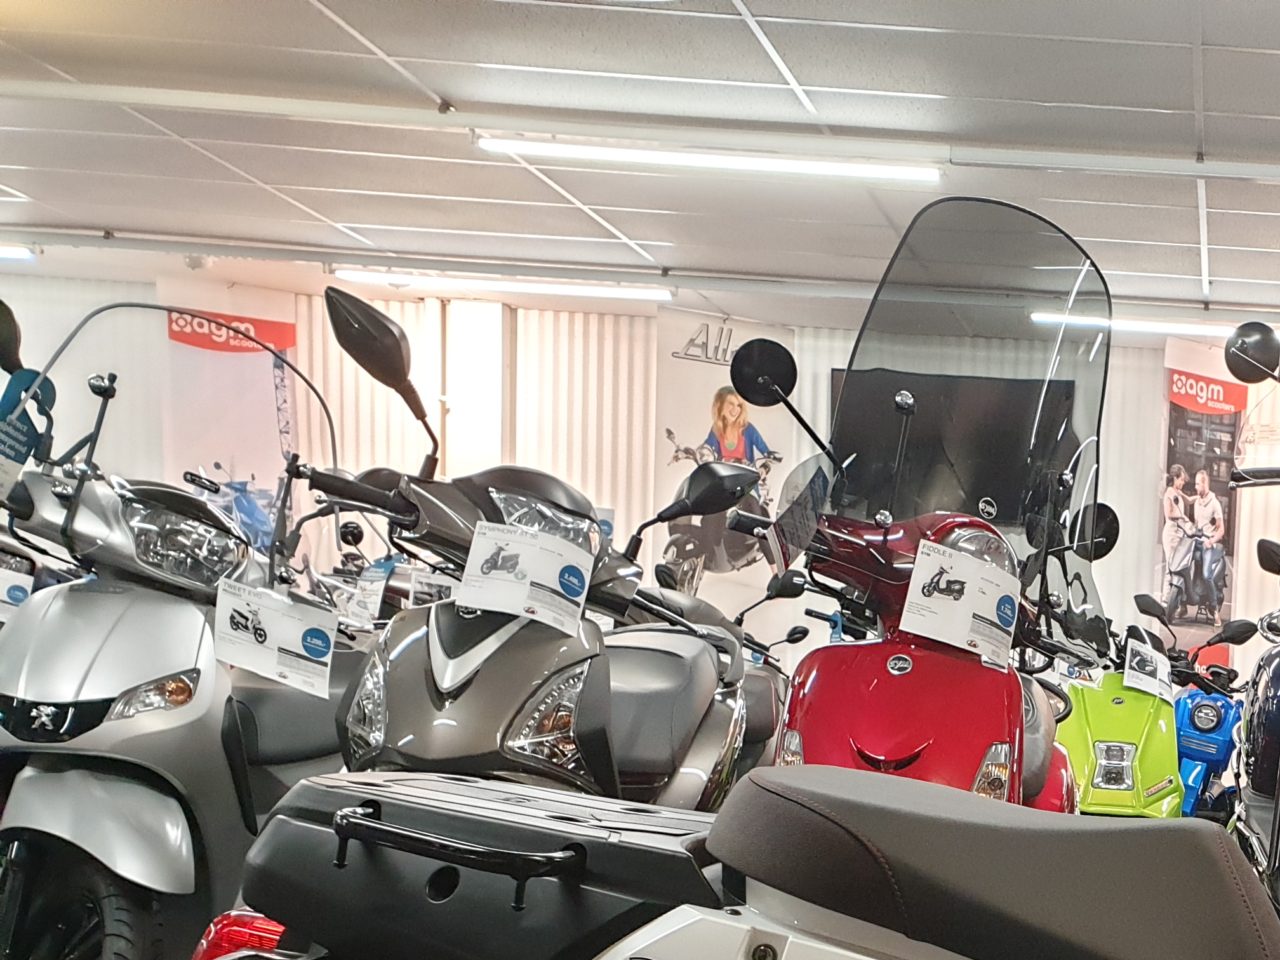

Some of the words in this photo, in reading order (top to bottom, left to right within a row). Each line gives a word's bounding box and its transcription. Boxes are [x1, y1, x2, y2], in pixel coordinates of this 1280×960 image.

[680, 323, 738, 362] All
[1186, 378, 1224, 404] agm
[922, 543, 947, 557] FIDDLE
